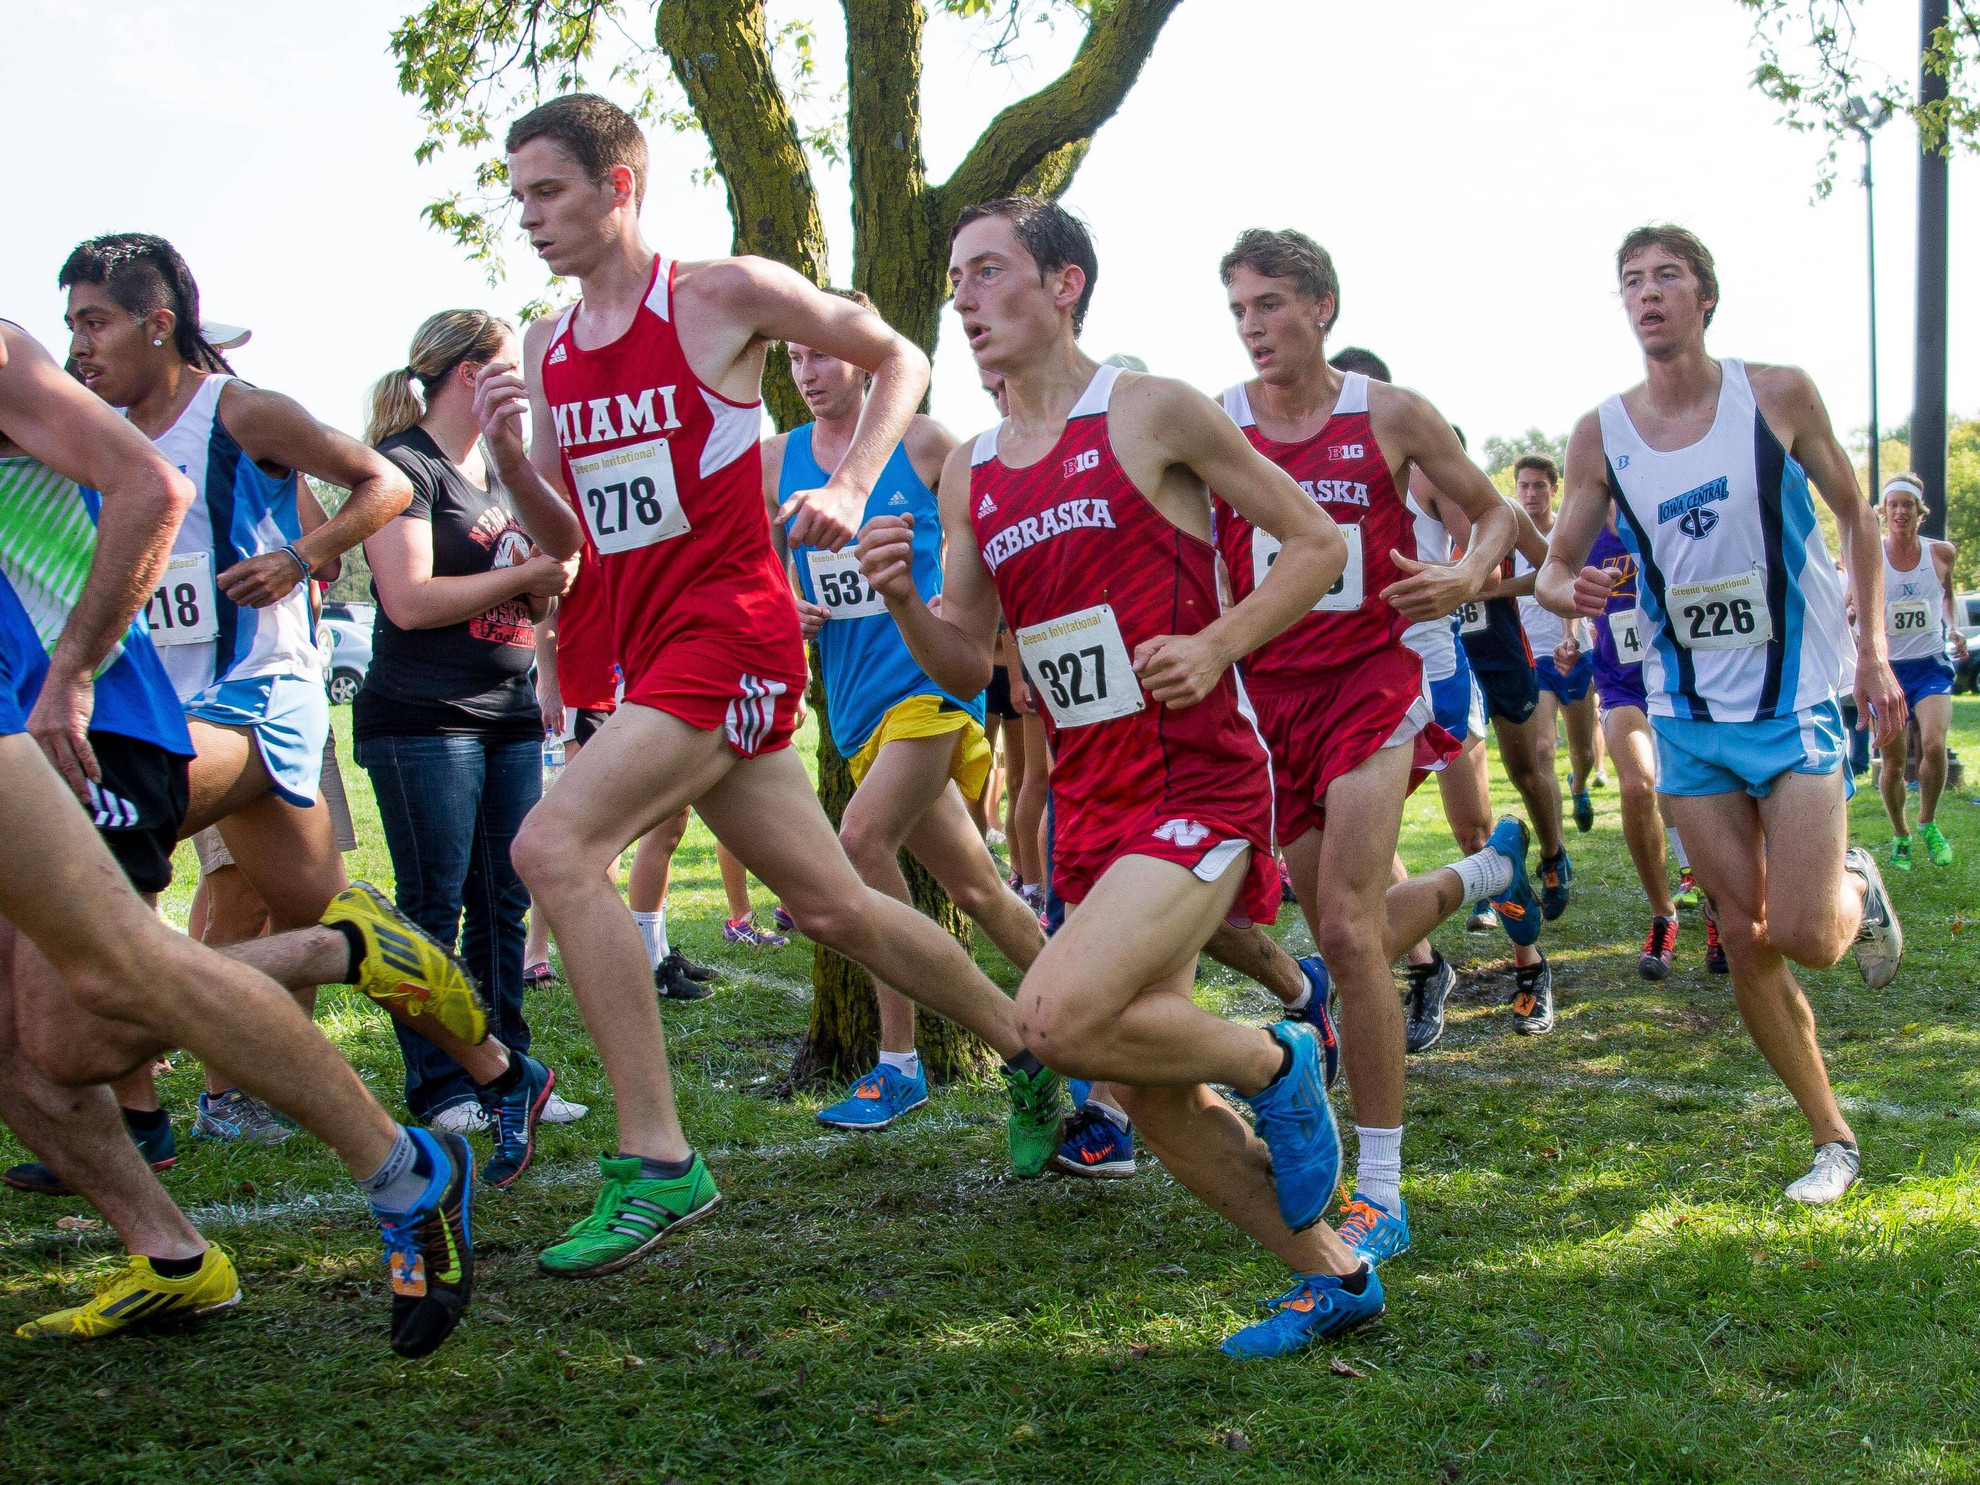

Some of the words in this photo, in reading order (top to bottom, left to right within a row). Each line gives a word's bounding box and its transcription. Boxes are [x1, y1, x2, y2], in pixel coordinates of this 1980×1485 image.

[551, 385, 682, 447] MIAMI
[602, 446, 656, 468] Invitational
[587, 476, 662, 536] 278
[1299, 479, 1370, 507] ASKA
[1659, 499, 1684, 523] IOWA
[1687, 480, 1728, 508] CENTRAL
[982, 498, 1116, 577] NEBRASKA
[168, 557, 198, 569] ational
[1672, 585, 1700, 597] Greeno
[1702, 576, 1750, 593] Invitational
[1049, 613, 1102, 638] Invitational
[1683, 599, 1755, 639] 226
[1894, 611, 1926, 629] 378
[1624, 627, 1642, 652] 4
[1038, 644, 1107, 708] 327
[1151, 818, 1211, 847] N
